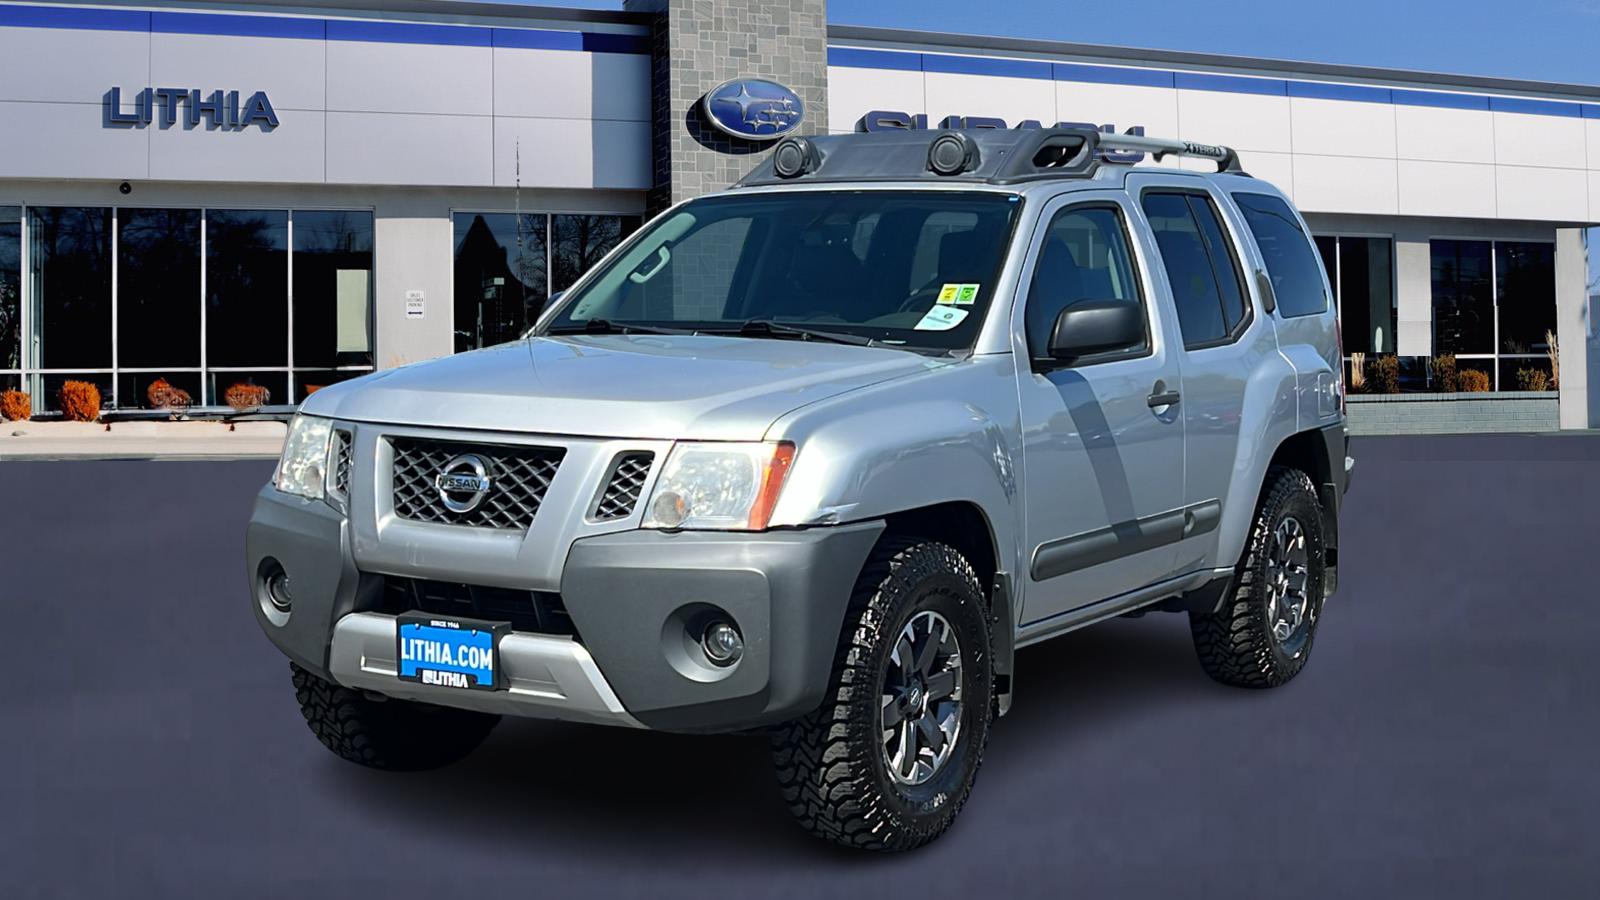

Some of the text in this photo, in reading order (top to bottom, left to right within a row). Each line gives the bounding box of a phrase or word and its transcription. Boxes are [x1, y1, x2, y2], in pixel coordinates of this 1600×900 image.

[110, 87, 280, 126] LITHIA
[439, 477, 481, 490] NISSAN
[401, 637, 493, 671] LITHIA.COM
[433, 670, 468, 688] LITHIA
